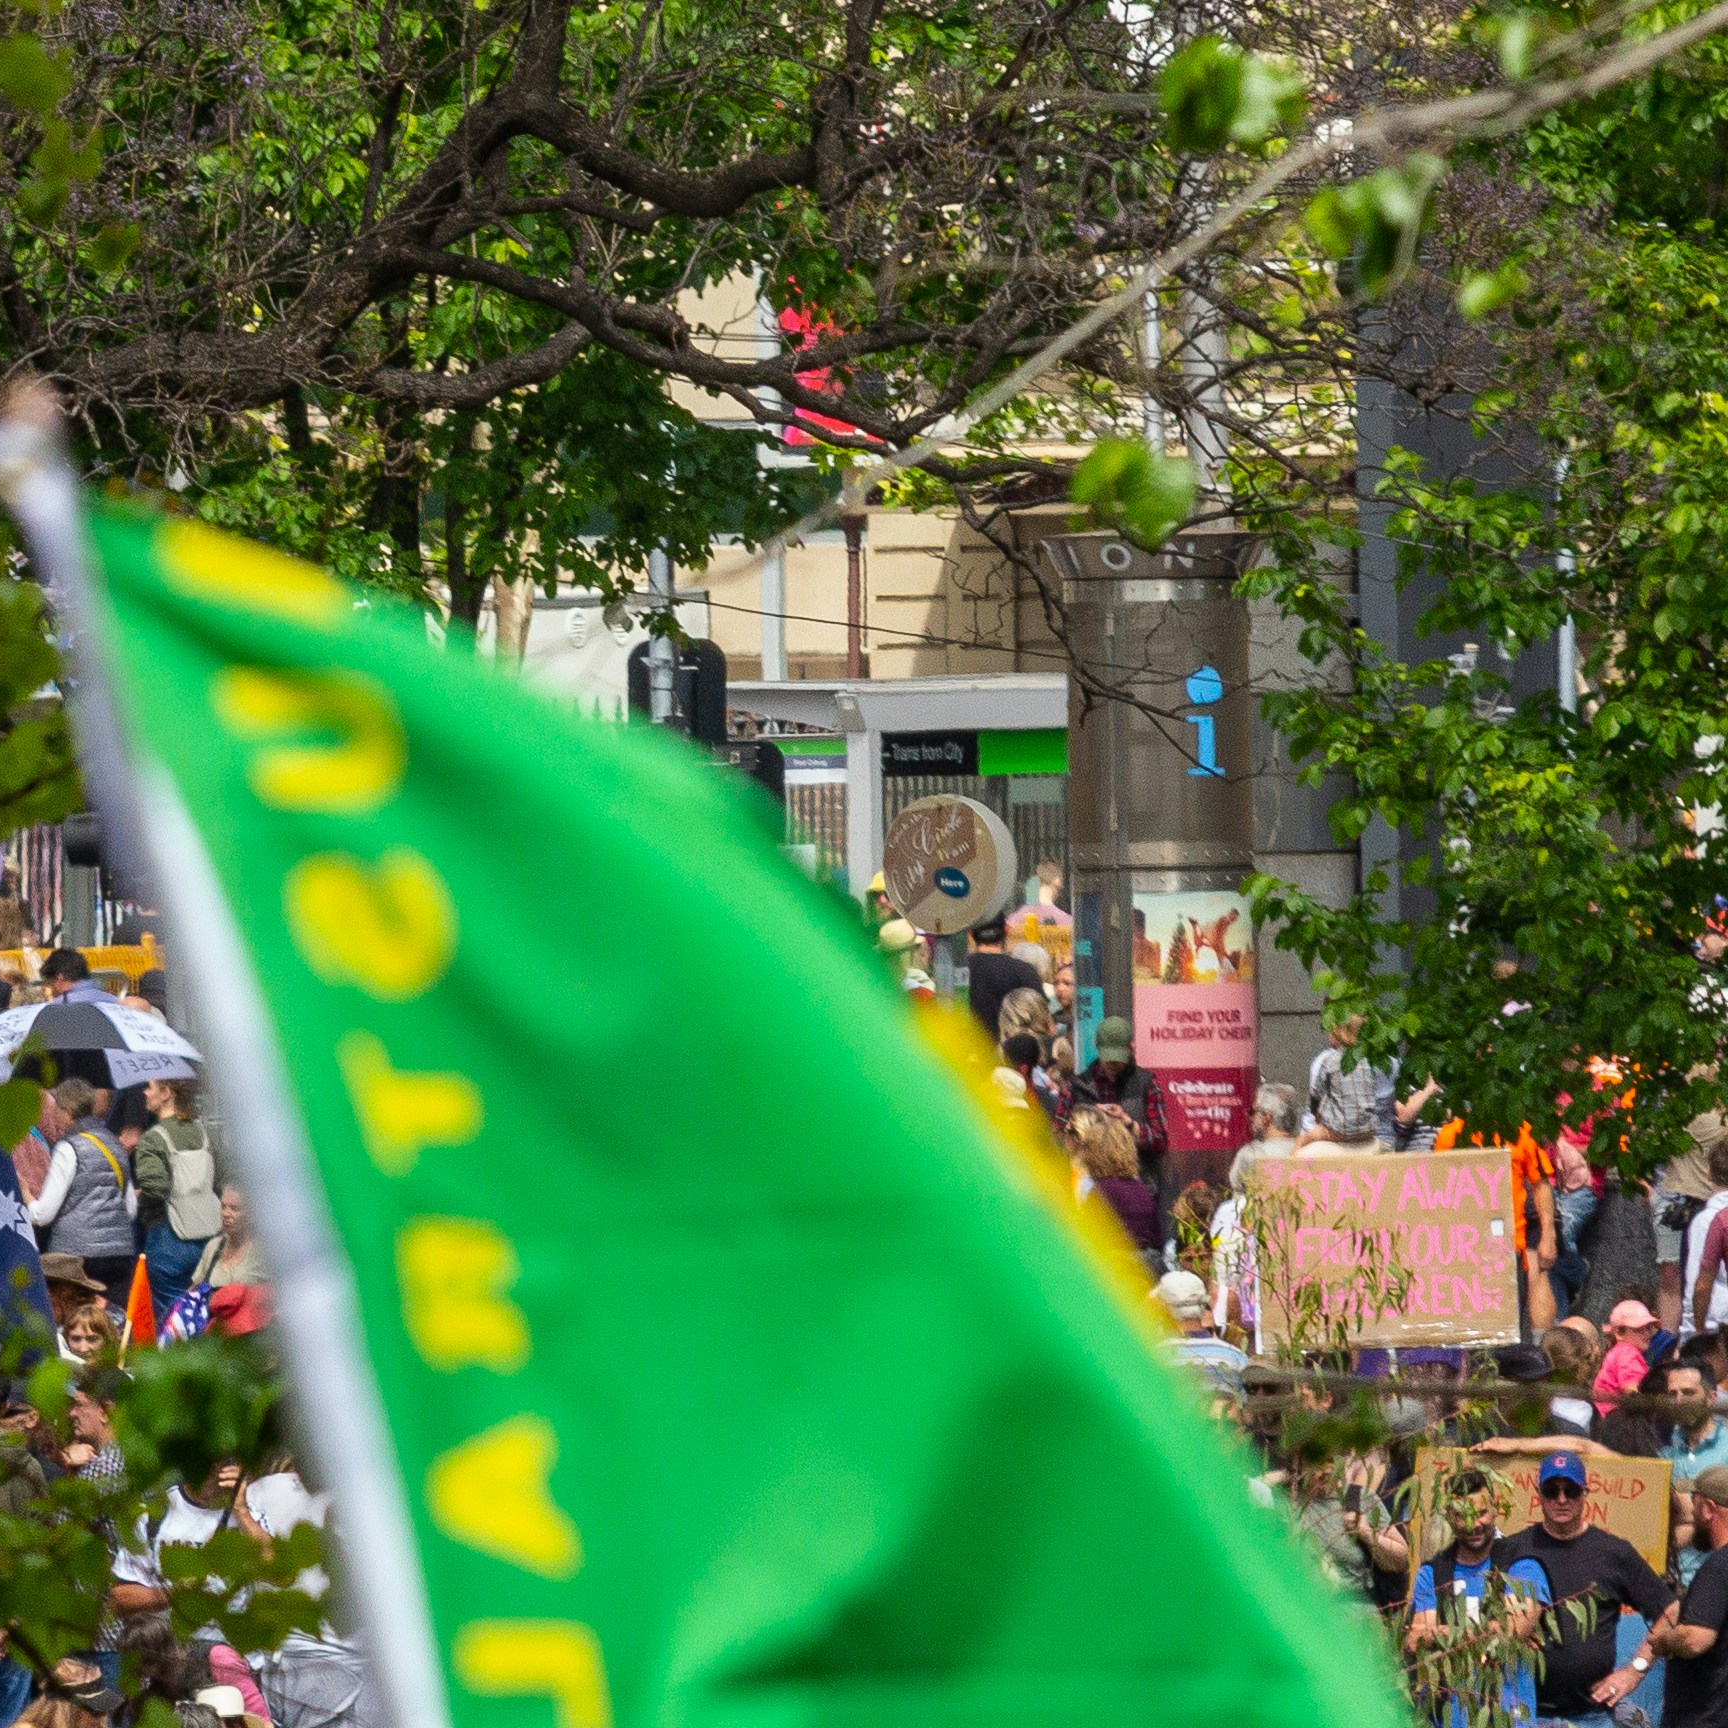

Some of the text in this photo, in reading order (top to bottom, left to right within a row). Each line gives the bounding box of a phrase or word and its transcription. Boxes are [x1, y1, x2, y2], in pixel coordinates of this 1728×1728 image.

[1167, 1009, 1242, 1023] FIND YOUR
[1150, 1026, 1214, 1041] HOLIDAY
[1291, 1157, 1506, 1215] STAY AWAY
[1408, 1223, 1481, 1267] OUR
